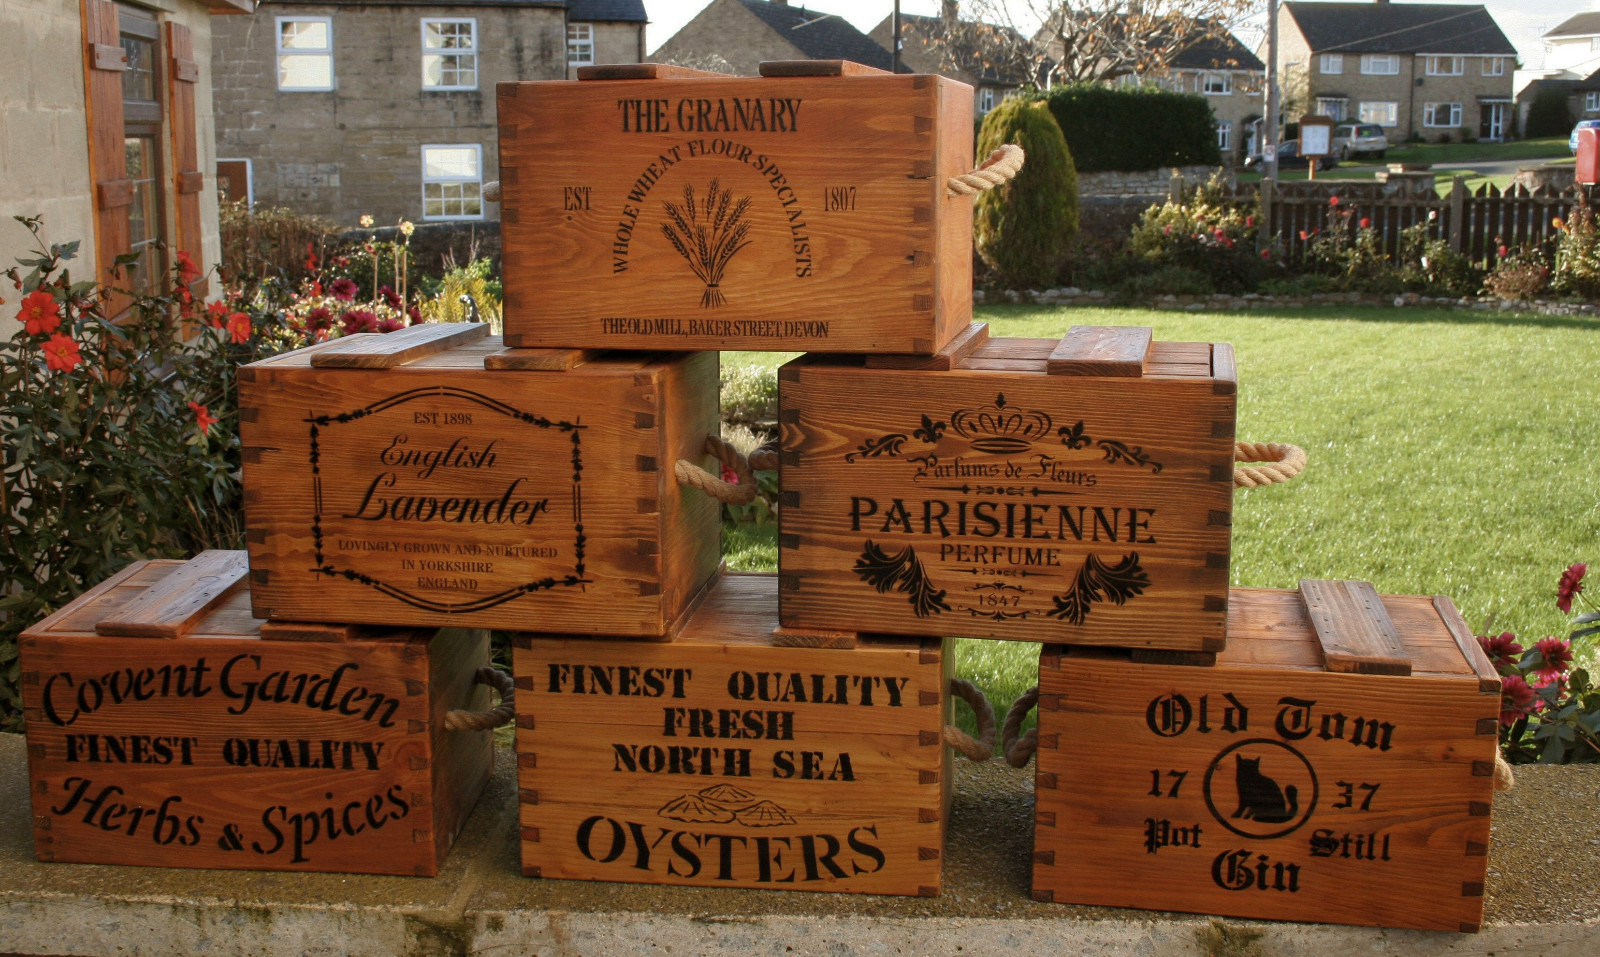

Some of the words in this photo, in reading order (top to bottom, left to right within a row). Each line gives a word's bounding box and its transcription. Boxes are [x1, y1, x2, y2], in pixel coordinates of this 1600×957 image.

[617, 98, 670, 133] THE
[677, 97, 803, 132] GRANARY
[564, 186, 592, 211] EST
[613, 204, 640, 274] WHOLE
[627, 145, 682, 203] WHEAT
[686, 138, 753, 164] FLOUR
[752, 154, 813, 278] SPECIALISTS
[824, 186, 857, 212] 1807
[600, 317, 627, 334] THE
[688, 319, 732, 337] BAKER
[783, 320, 829, 338] DEVON
[414, 412, 439, 424] EST
[443, 412, 473, 425] 1898
[380, 434, 504, 479] English
[906, 453, 1000, 483] Parfums
[1004, 459, 1023, 479] de
[1026, 453, 1098, 487] Fleurs
[342, 471, 551, 526] Lavender
[847, 496, 1158, 544] PARISIENNE
[338, 539, 401, 553] LOVINGLY
[403, 542, 452, 556] GROWN
[454, 543, 482, 556] AND
[486, 545, 558, 558] NURTURED
[401, 559, 415, 570] IN
[419, 560, 494, 573] YORKSHIRE
[938, 543, 1062, 567] PERFUME
[417, 576, 478, 591] ENGLAND
[977, 593, 1021, 607] 1847
[42, 656, 212, 727] Covent
[219, 653, 401, 729] Garden
[547, 663, 692, 699] FINEST
[727, 670, 910, 707] QUALITY
[662, 707, 795, 741] FRESH
[1145, 692, 1249, 738] Old
[1274, 696, 1397, 752] Tom
[65, 733, 198, 766] FINEST
[222, 737, 385, 771] QUALITY
[612, 743, 752, 778] NORTH
[772, 750, 856, 782] SEA
[1147, 768, 1189, 799] 17
[1331, 780, 1381, 811] 37
[51, 776, 205, 846] Herbs
[252, 784, 410, 865] Spices
[1144, 817, 1203, 855] Pot
[575, 815, 886, 883] OYSTERS
[1308, 828, 1392, 862] Still
[1211, 848, 1302, 893] Gin
